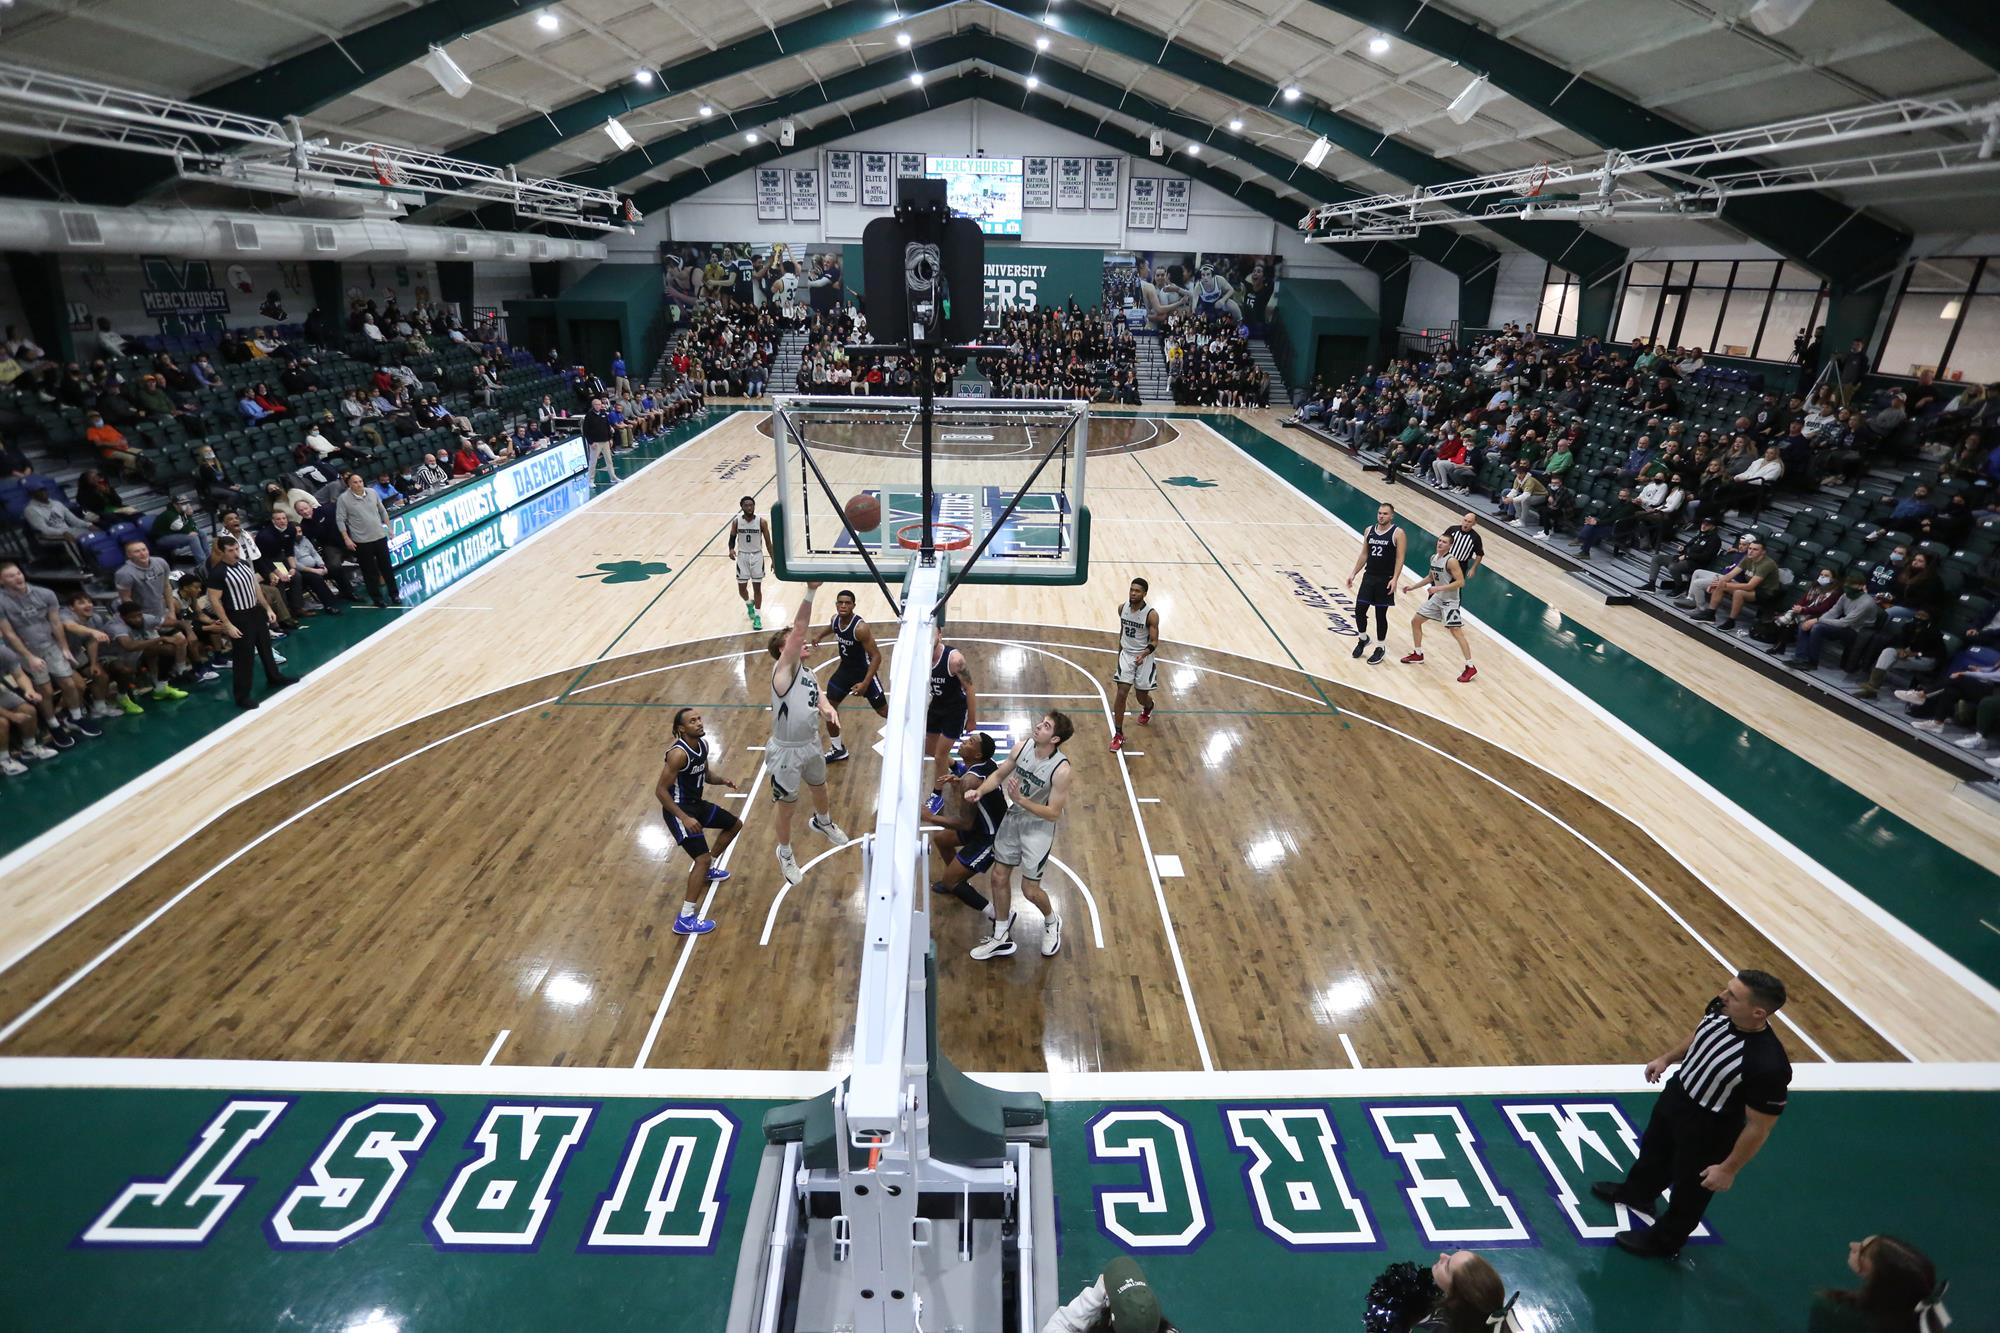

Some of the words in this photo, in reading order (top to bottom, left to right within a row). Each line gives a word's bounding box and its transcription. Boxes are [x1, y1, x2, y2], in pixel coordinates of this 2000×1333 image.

[935, 160, 1013, 172] MERCYHURST
[143, 291, 227, 310] MERCYHURST
[984, 279, 1037, 312] ERS
[513, 451, 566, 498] DAEMEN
[410, 481, 496, 550] MERCYHURST
[746, 534, 752, 543] 0
[1371, 545, 1383, 557] 22
[1125, 626, 1136, 638] 22
[840, 645, 849, 657] 2
